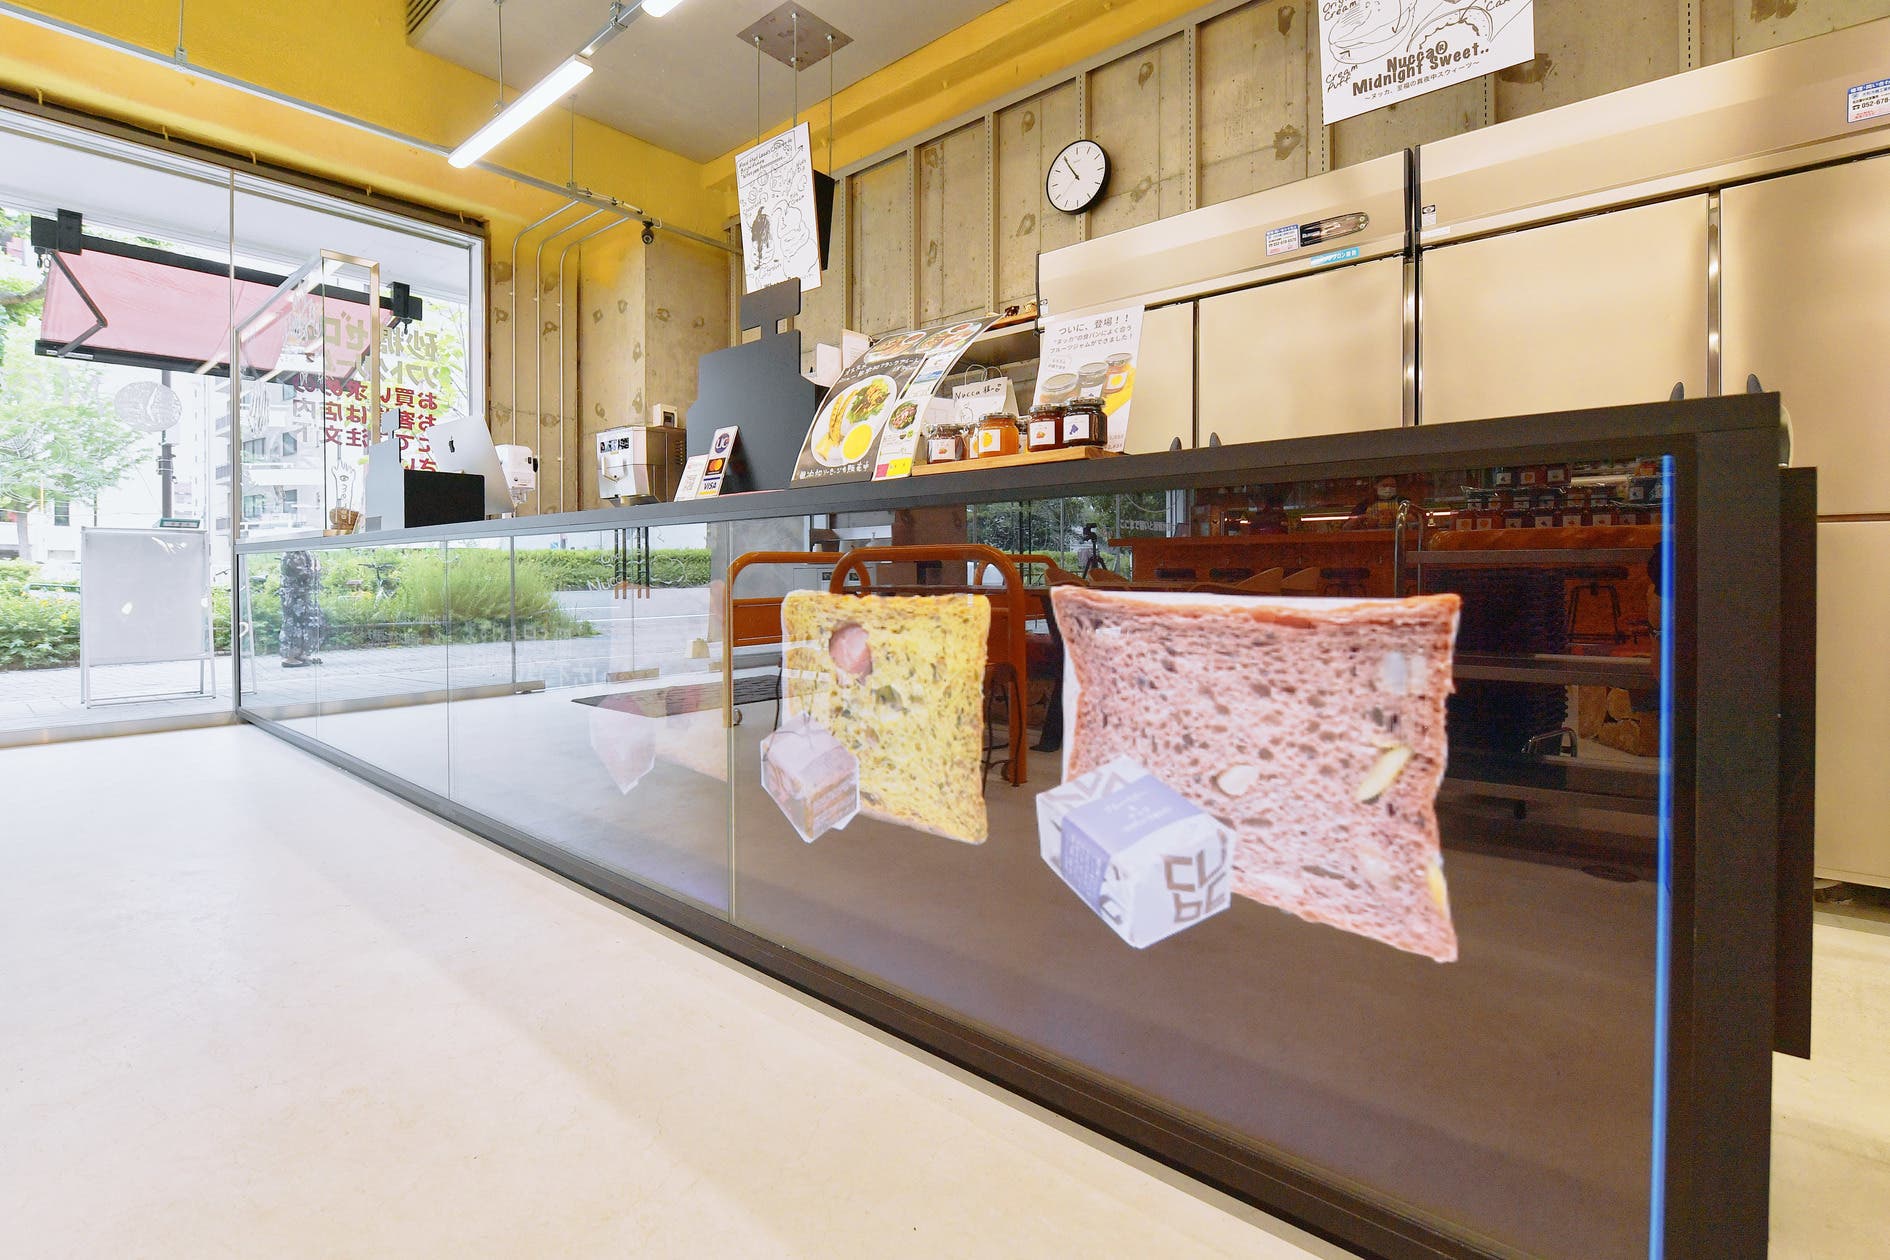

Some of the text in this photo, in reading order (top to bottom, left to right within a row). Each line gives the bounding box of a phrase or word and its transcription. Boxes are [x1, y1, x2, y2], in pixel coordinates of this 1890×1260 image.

[1326, 65, 1358, 84] Cream
[1352, 63, 1422, 96] Midnight
[704, 481, 717, 490] VISA
